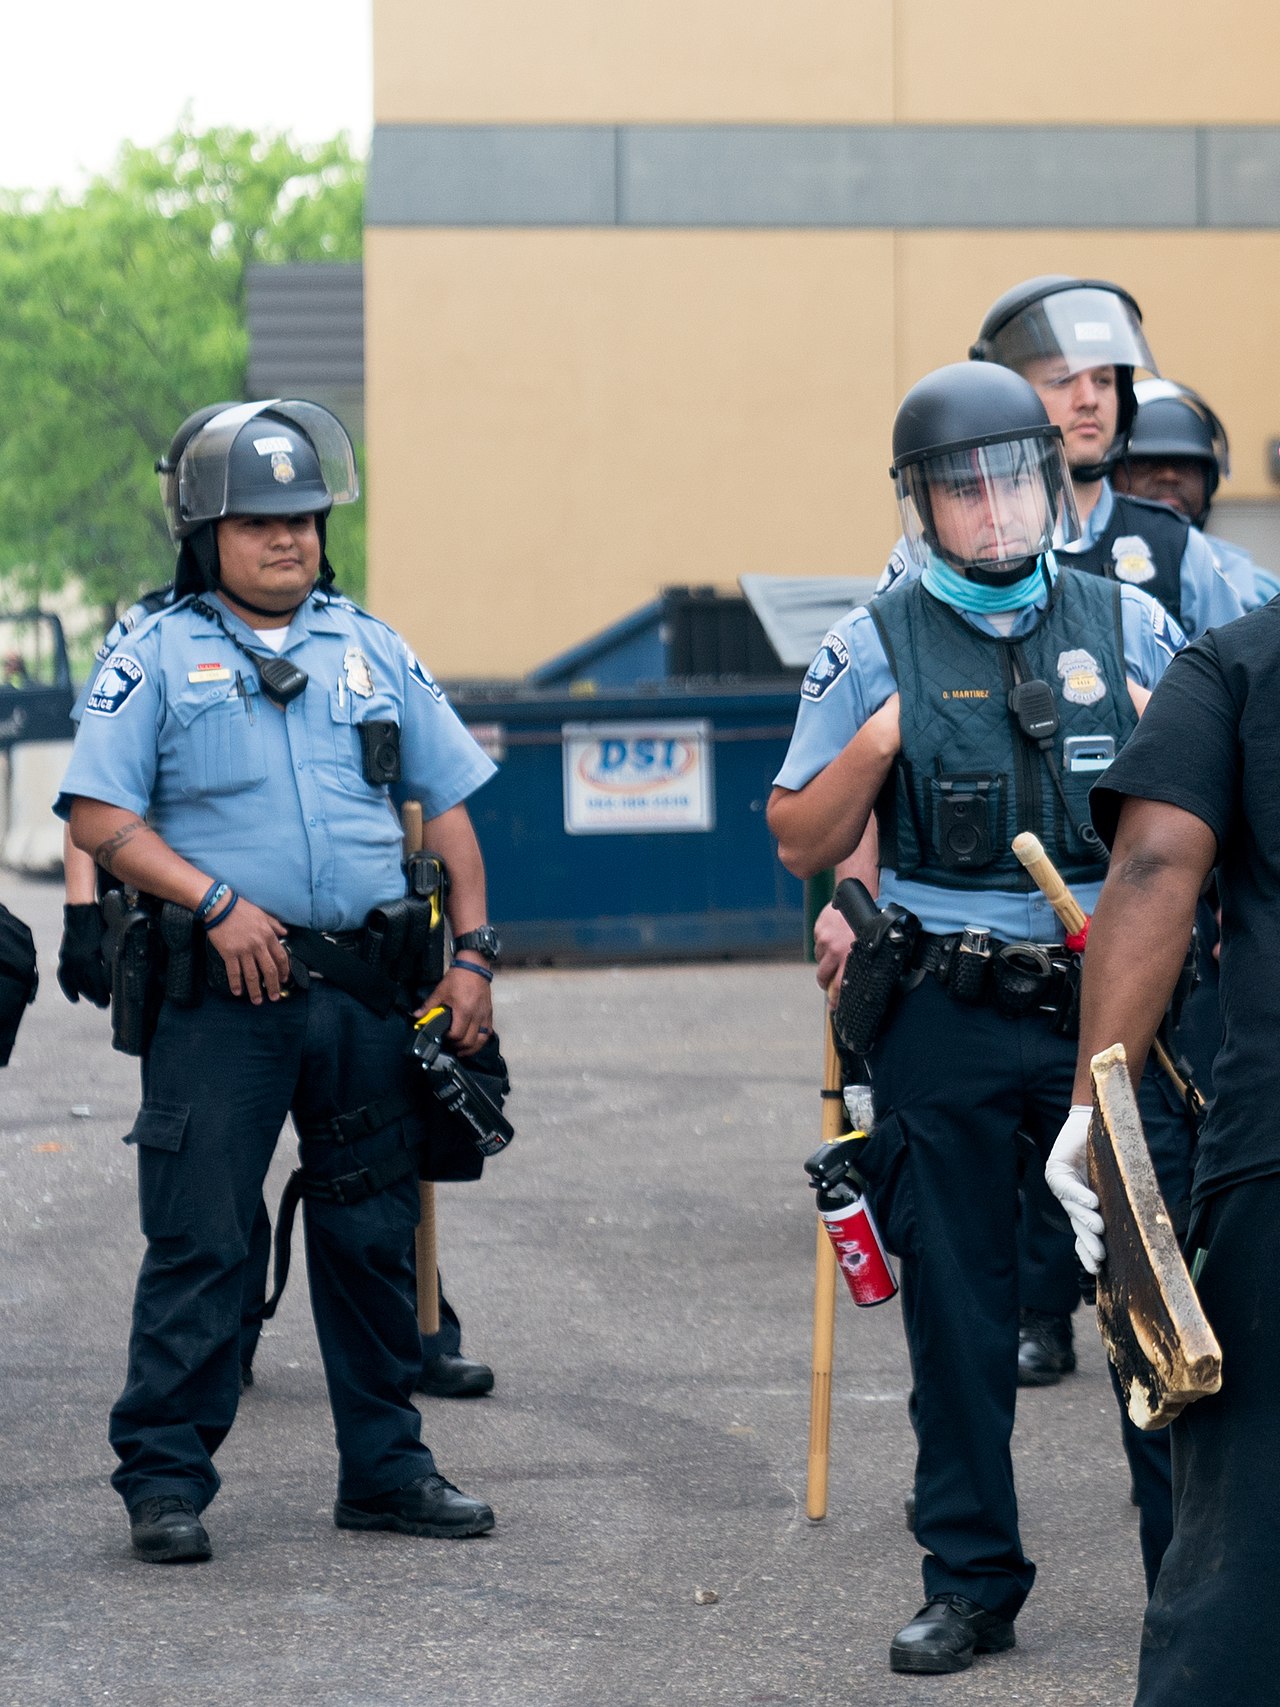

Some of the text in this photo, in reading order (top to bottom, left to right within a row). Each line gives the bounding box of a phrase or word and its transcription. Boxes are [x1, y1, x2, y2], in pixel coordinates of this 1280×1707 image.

[952, 689, 990, 699] MARTINEZ
[87, 696, 115, 711] OLICE
[599, 738, 676, 772] DSI
